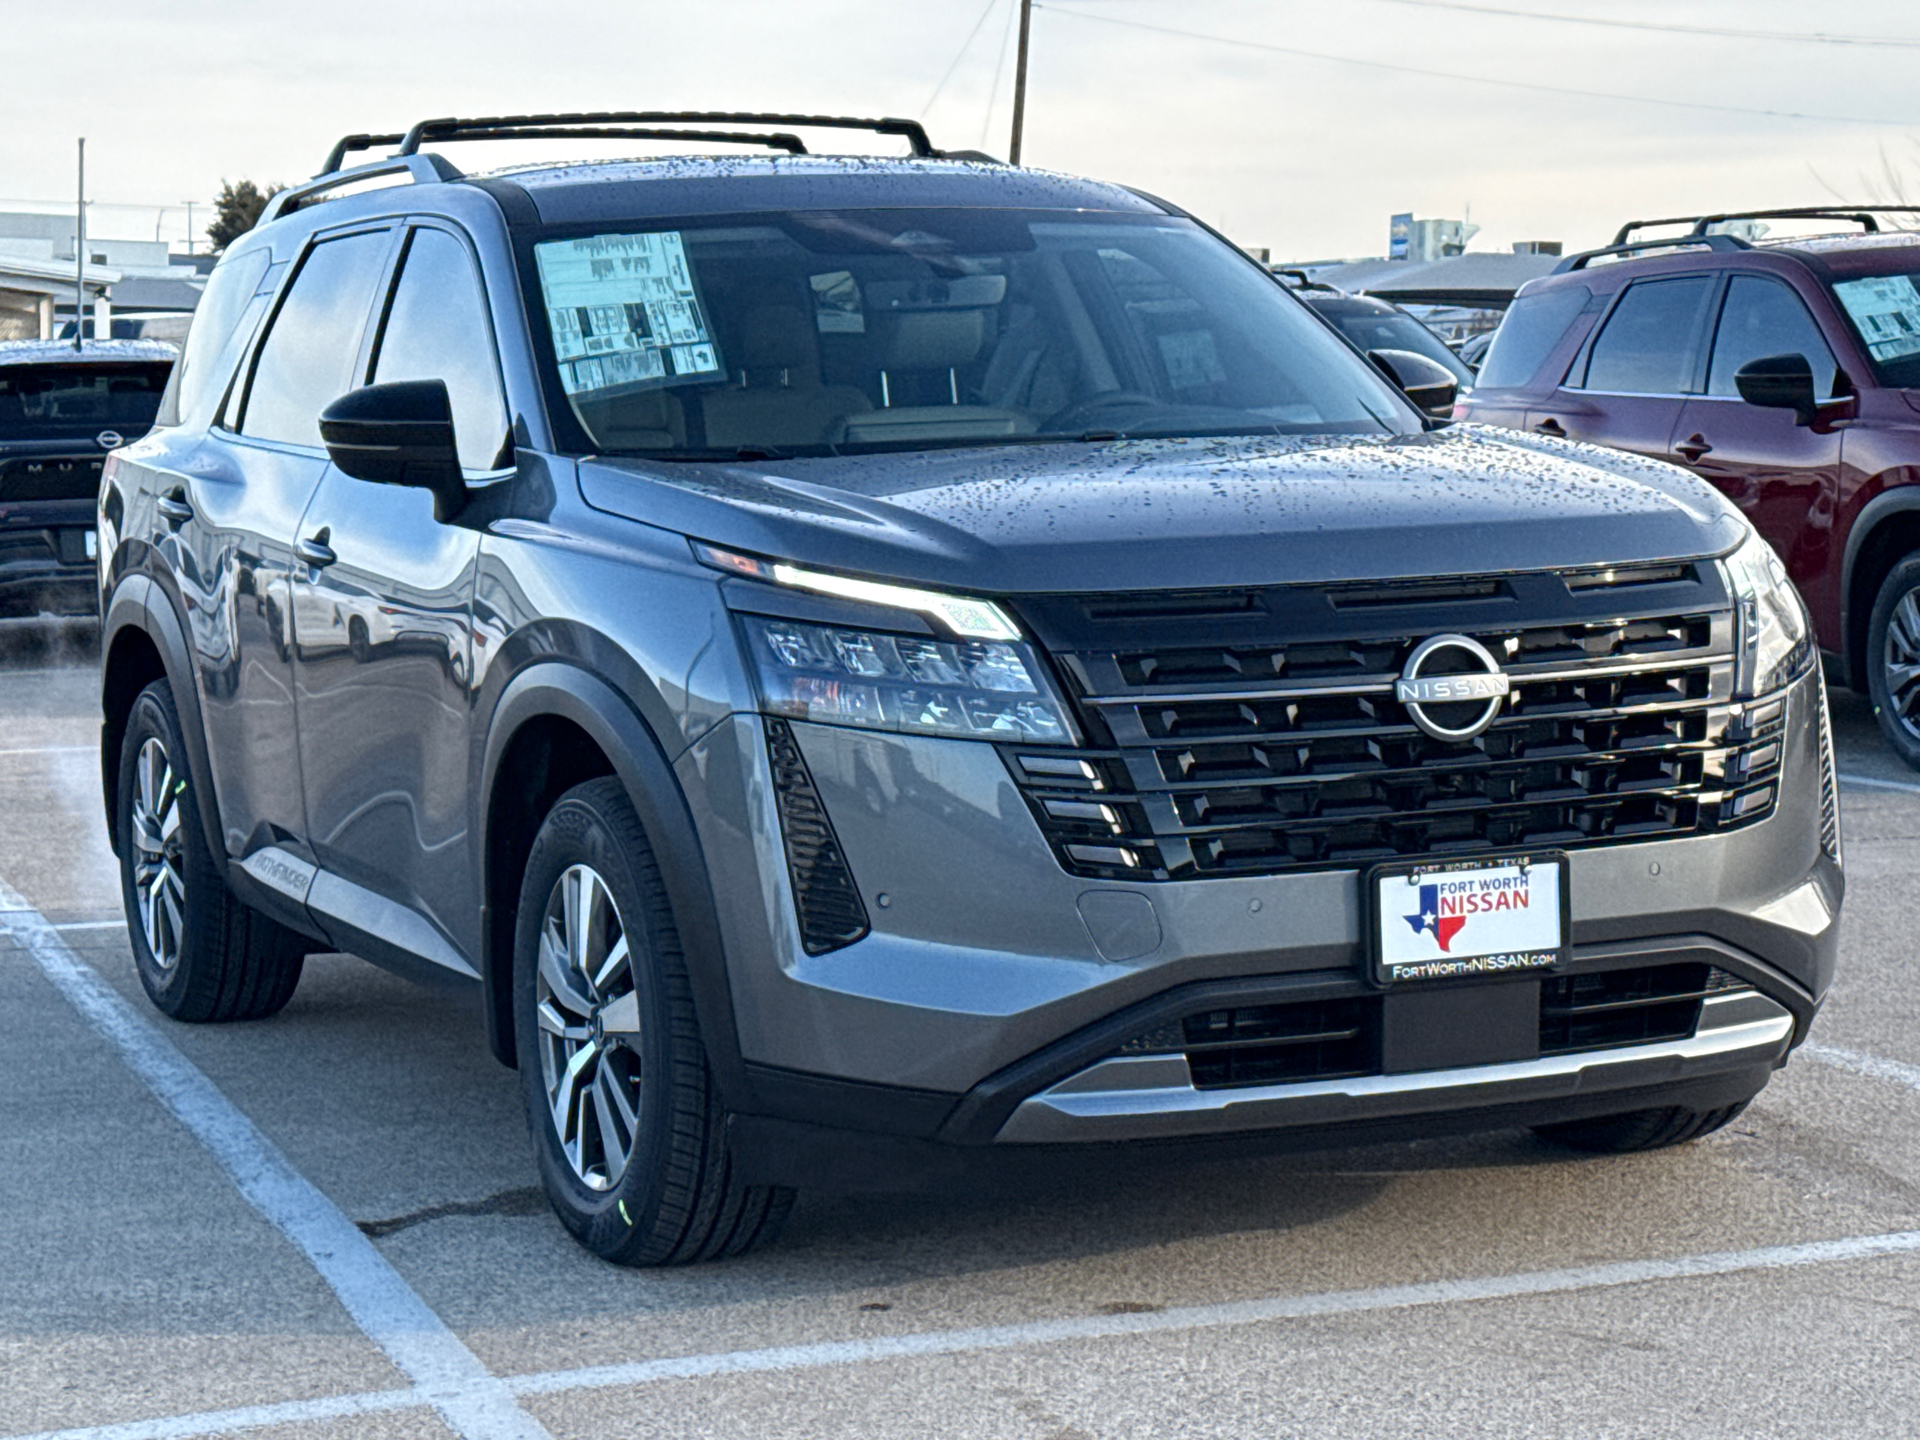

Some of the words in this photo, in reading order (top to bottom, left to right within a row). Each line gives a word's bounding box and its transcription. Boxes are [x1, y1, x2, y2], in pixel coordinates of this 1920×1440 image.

[1400, 678, 1507, 699] NISSAN
[1413, 864, 1440, 874] FORT
[1445, 860, 1482, 872] WORTH
[1497, 856, 1530, 867] TEXAS
[1440, 880, 1475, 895] FORT
[1479, 874, 1529, 892] WORTH
[1440, 889, 1529, 915] NISSAN
